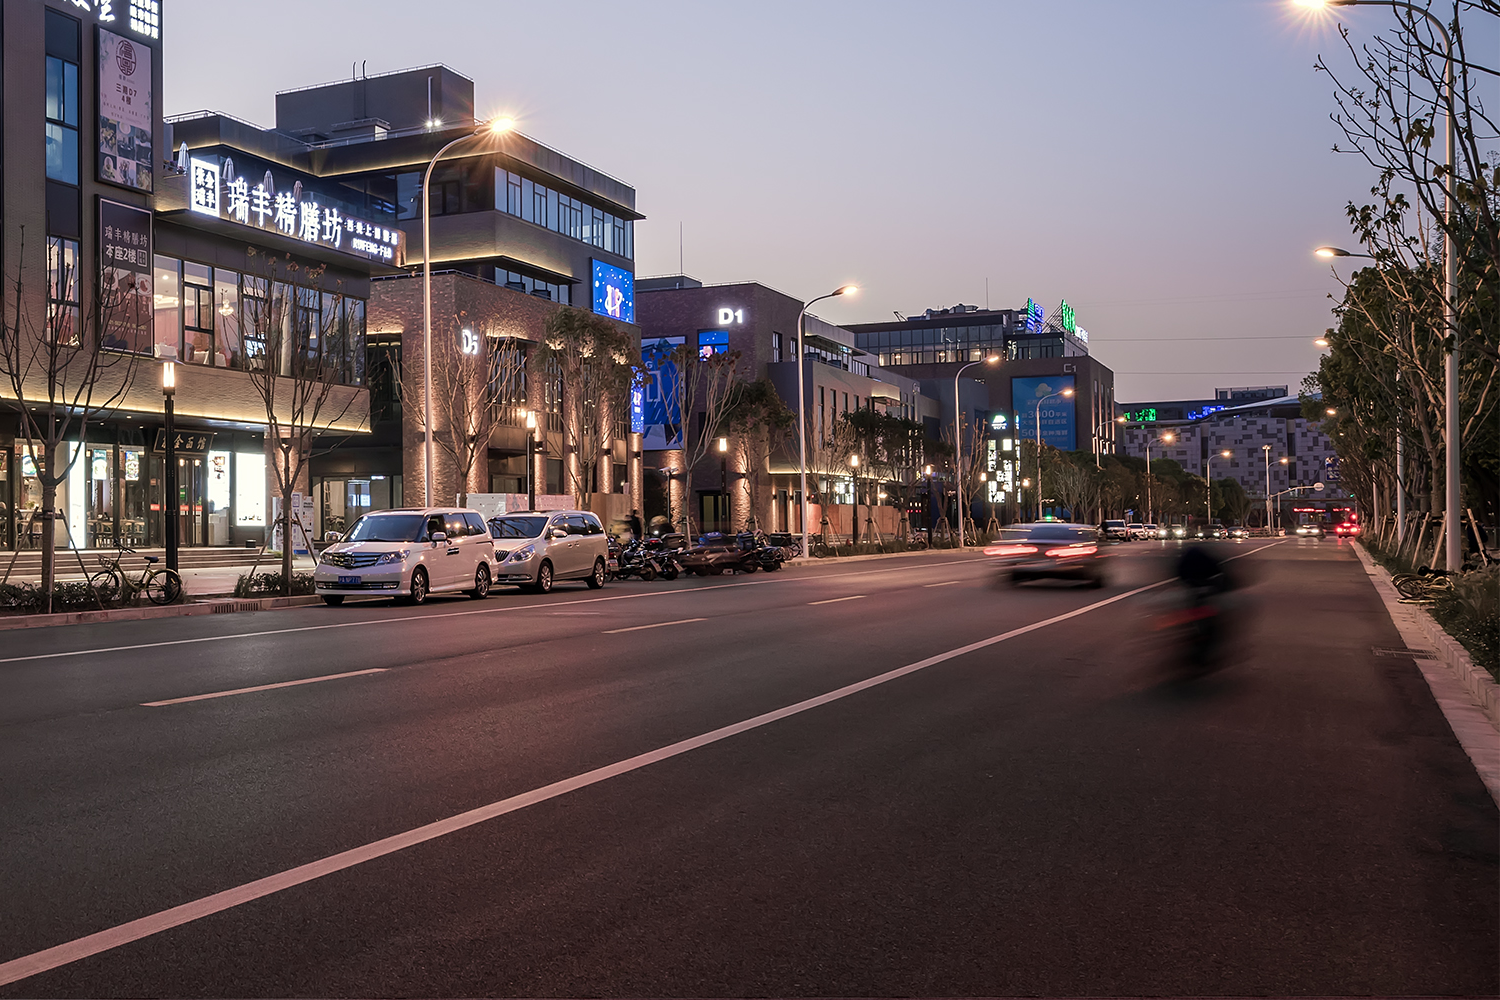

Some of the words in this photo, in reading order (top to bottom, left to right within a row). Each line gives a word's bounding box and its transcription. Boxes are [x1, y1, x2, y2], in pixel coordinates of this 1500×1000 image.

[226, 176, 343, 248] 瑞丰精膳坊
[104, 224, 148, 247] 瑞丰精膳坊
[105, 243, 137, 264] 本座2楼
[718, 307, 744, 325] D1
[1063, 363, 1077, 373] C1
